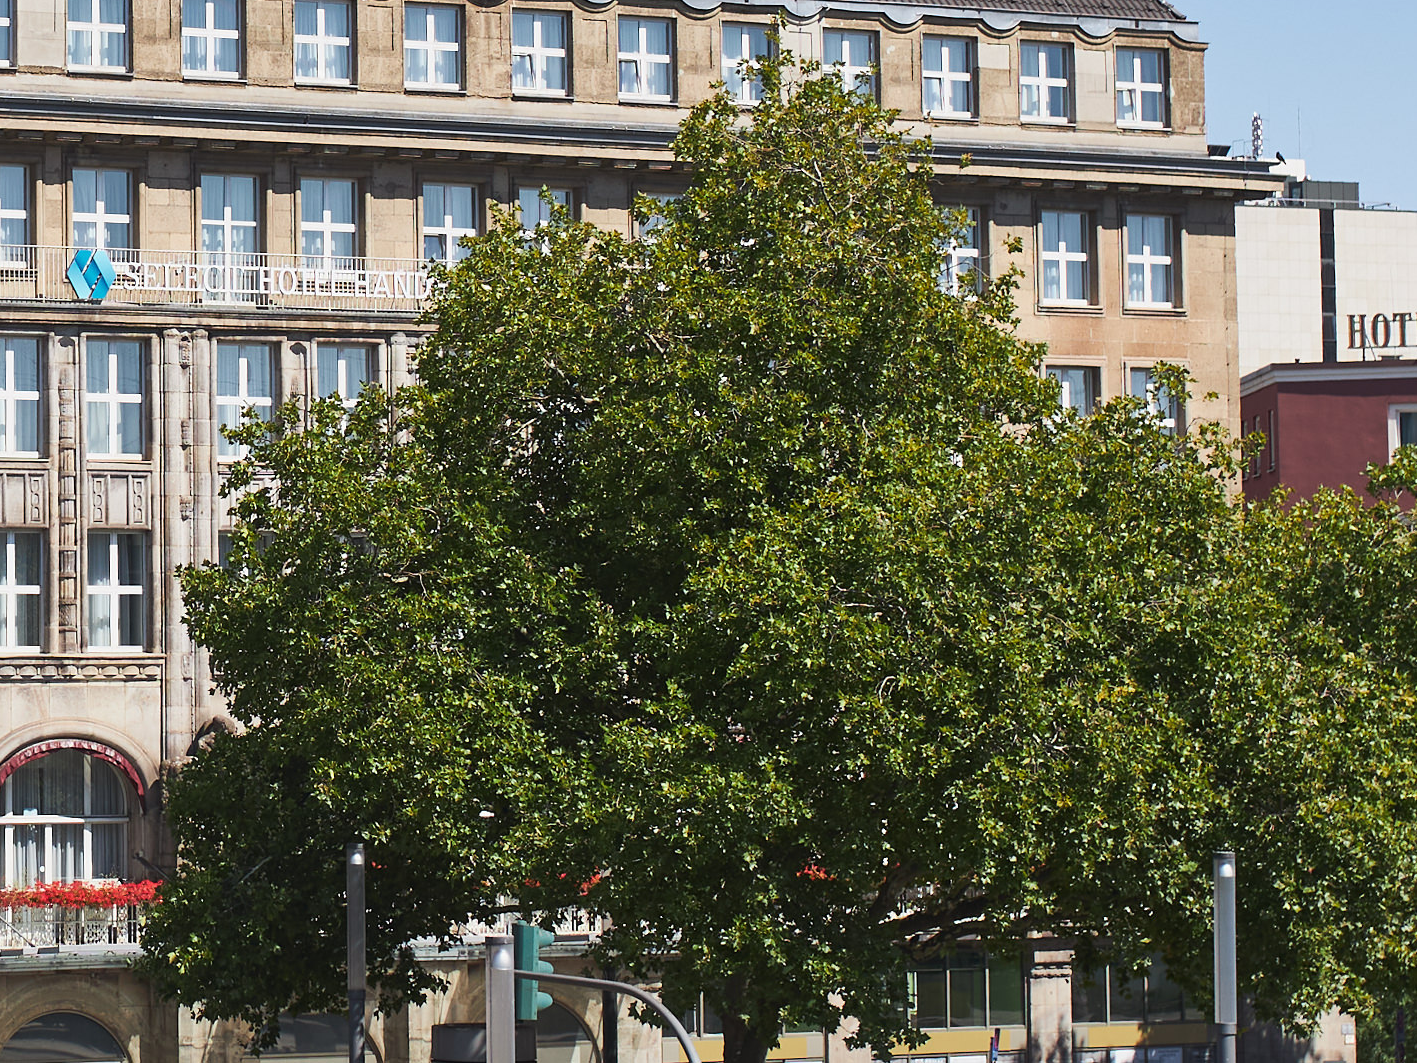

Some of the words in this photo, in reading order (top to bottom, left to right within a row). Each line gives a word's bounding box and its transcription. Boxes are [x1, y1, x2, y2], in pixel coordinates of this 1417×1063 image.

[123, 262, 246, 294] SELECT
[259, 265, 350, 297] HOTEL
[354, 269, 448, 300] HAND
[1346, 311, 1417, 349] HOT
